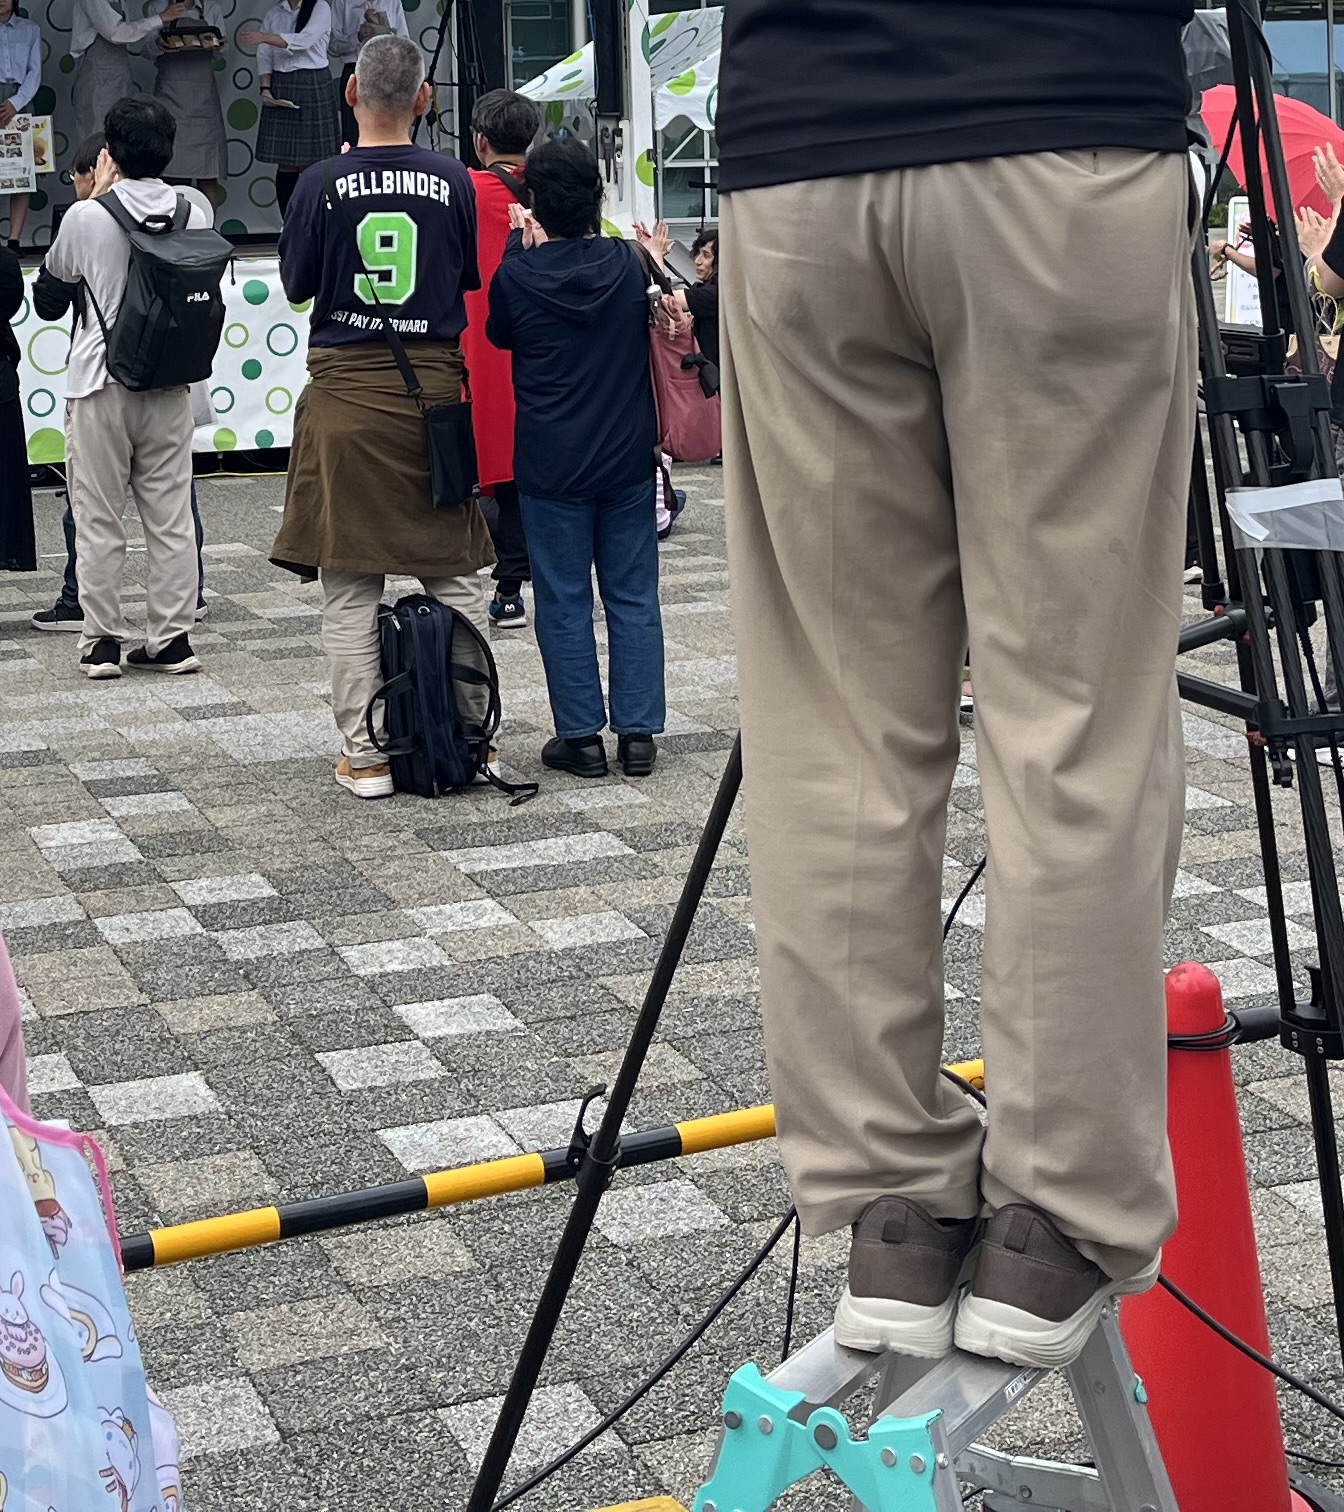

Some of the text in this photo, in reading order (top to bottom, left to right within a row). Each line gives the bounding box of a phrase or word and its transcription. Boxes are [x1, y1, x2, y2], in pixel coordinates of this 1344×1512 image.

[353, 211, 419, 306] 9
[187, 291, 210, 303] FILA
[348, 312, 370, 330] PAY
[379, 317, 429, 333] RWARD
